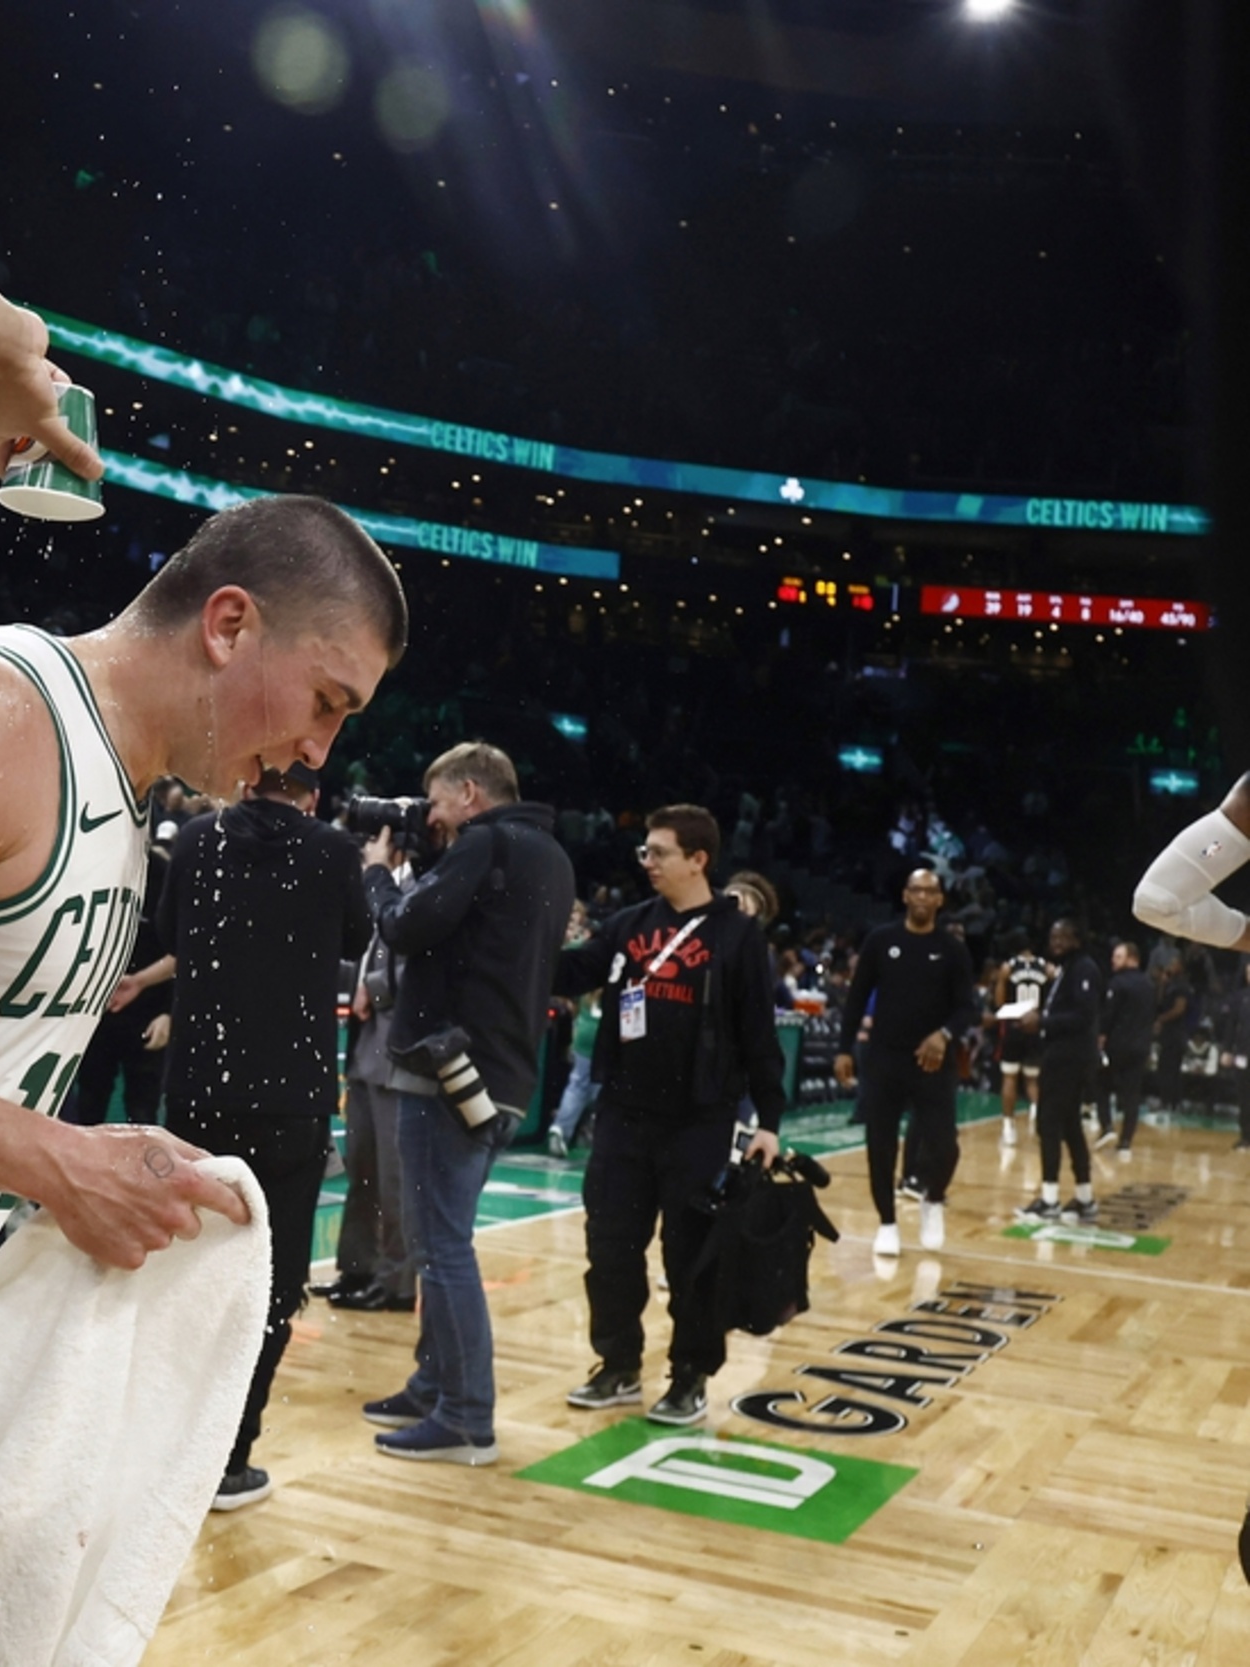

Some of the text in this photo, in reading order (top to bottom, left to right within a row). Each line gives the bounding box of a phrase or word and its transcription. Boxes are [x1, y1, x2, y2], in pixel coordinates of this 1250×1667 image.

[430, 420, 555, 472] CELTICS WIN
[1026, 498, 1168, 533] CELTICS WIN
[416, 521, 539, 569] CELTICS WIN
[728, 1281, 1064, 1437] GARDEN
